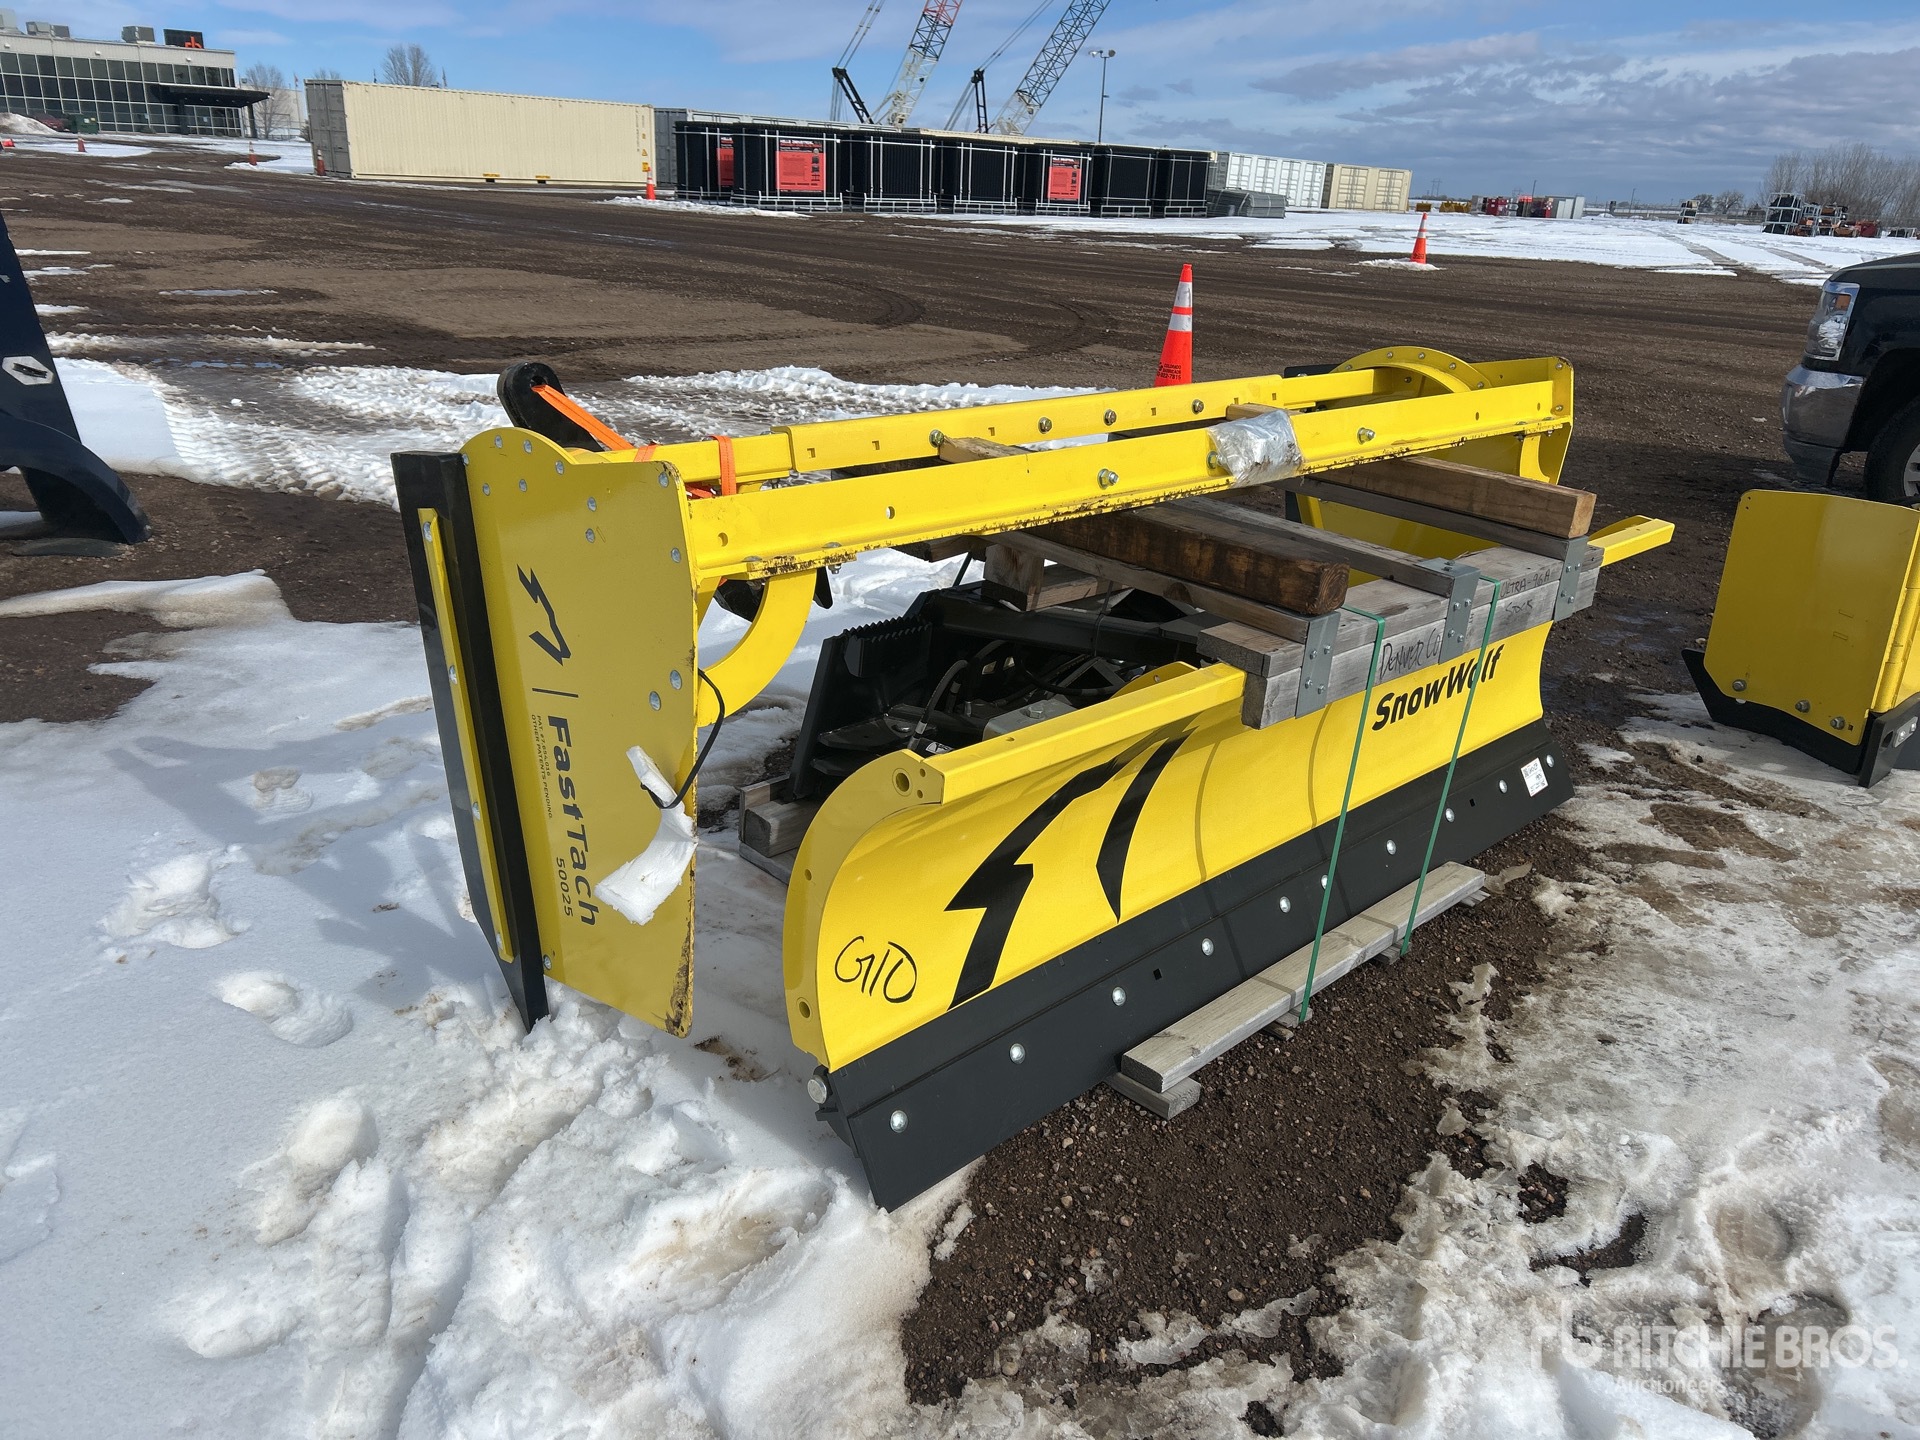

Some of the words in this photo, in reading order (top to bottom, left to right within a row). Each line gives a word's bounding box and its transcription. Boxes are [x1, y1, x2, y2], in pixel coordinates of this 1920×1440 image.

[531, 714, 540, 742] OTHER
[537, 743, 547, 781] PATENTS
[547, 715, 600, 926] FastTach
[556, 856, 574, 918] 50025
